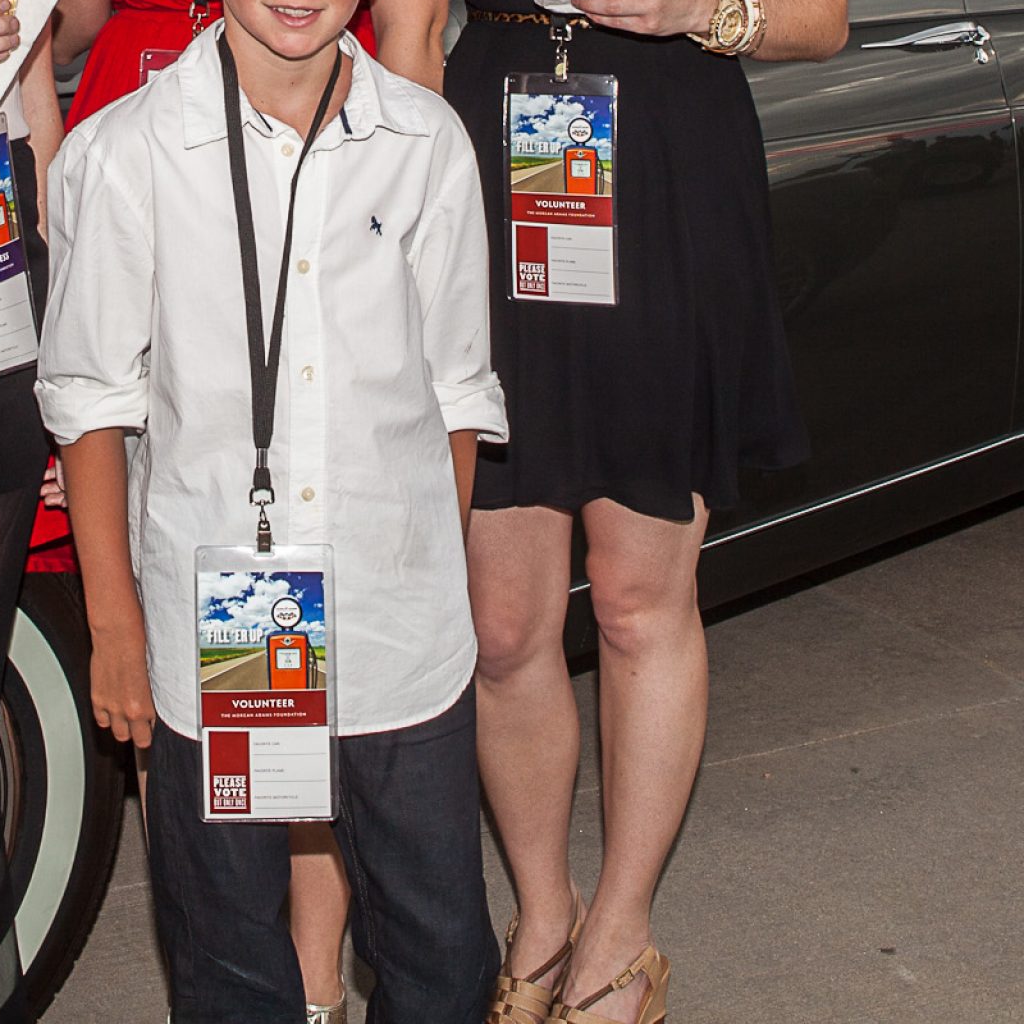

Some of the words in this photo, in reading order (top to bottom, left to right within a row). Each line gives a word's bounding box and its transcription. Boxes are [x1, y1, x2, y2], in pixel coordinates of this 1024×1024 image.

[516, 140, 535, 153] FILL
[550, 142, 562, 154] UP
[535, 199, 586, 210] VOLUNTEER
[519, 263, 545, 274] PLEASE
[519, 273, 546, 281] VOTE
[207, 629, 230, 644] FILL
[249, 628, 264, 643] UP
[231, 698, 295, 709] VOLUNTEER
[213, 777, 247, 788] PLEASE
[213, 787, 247, 797] VOTE
